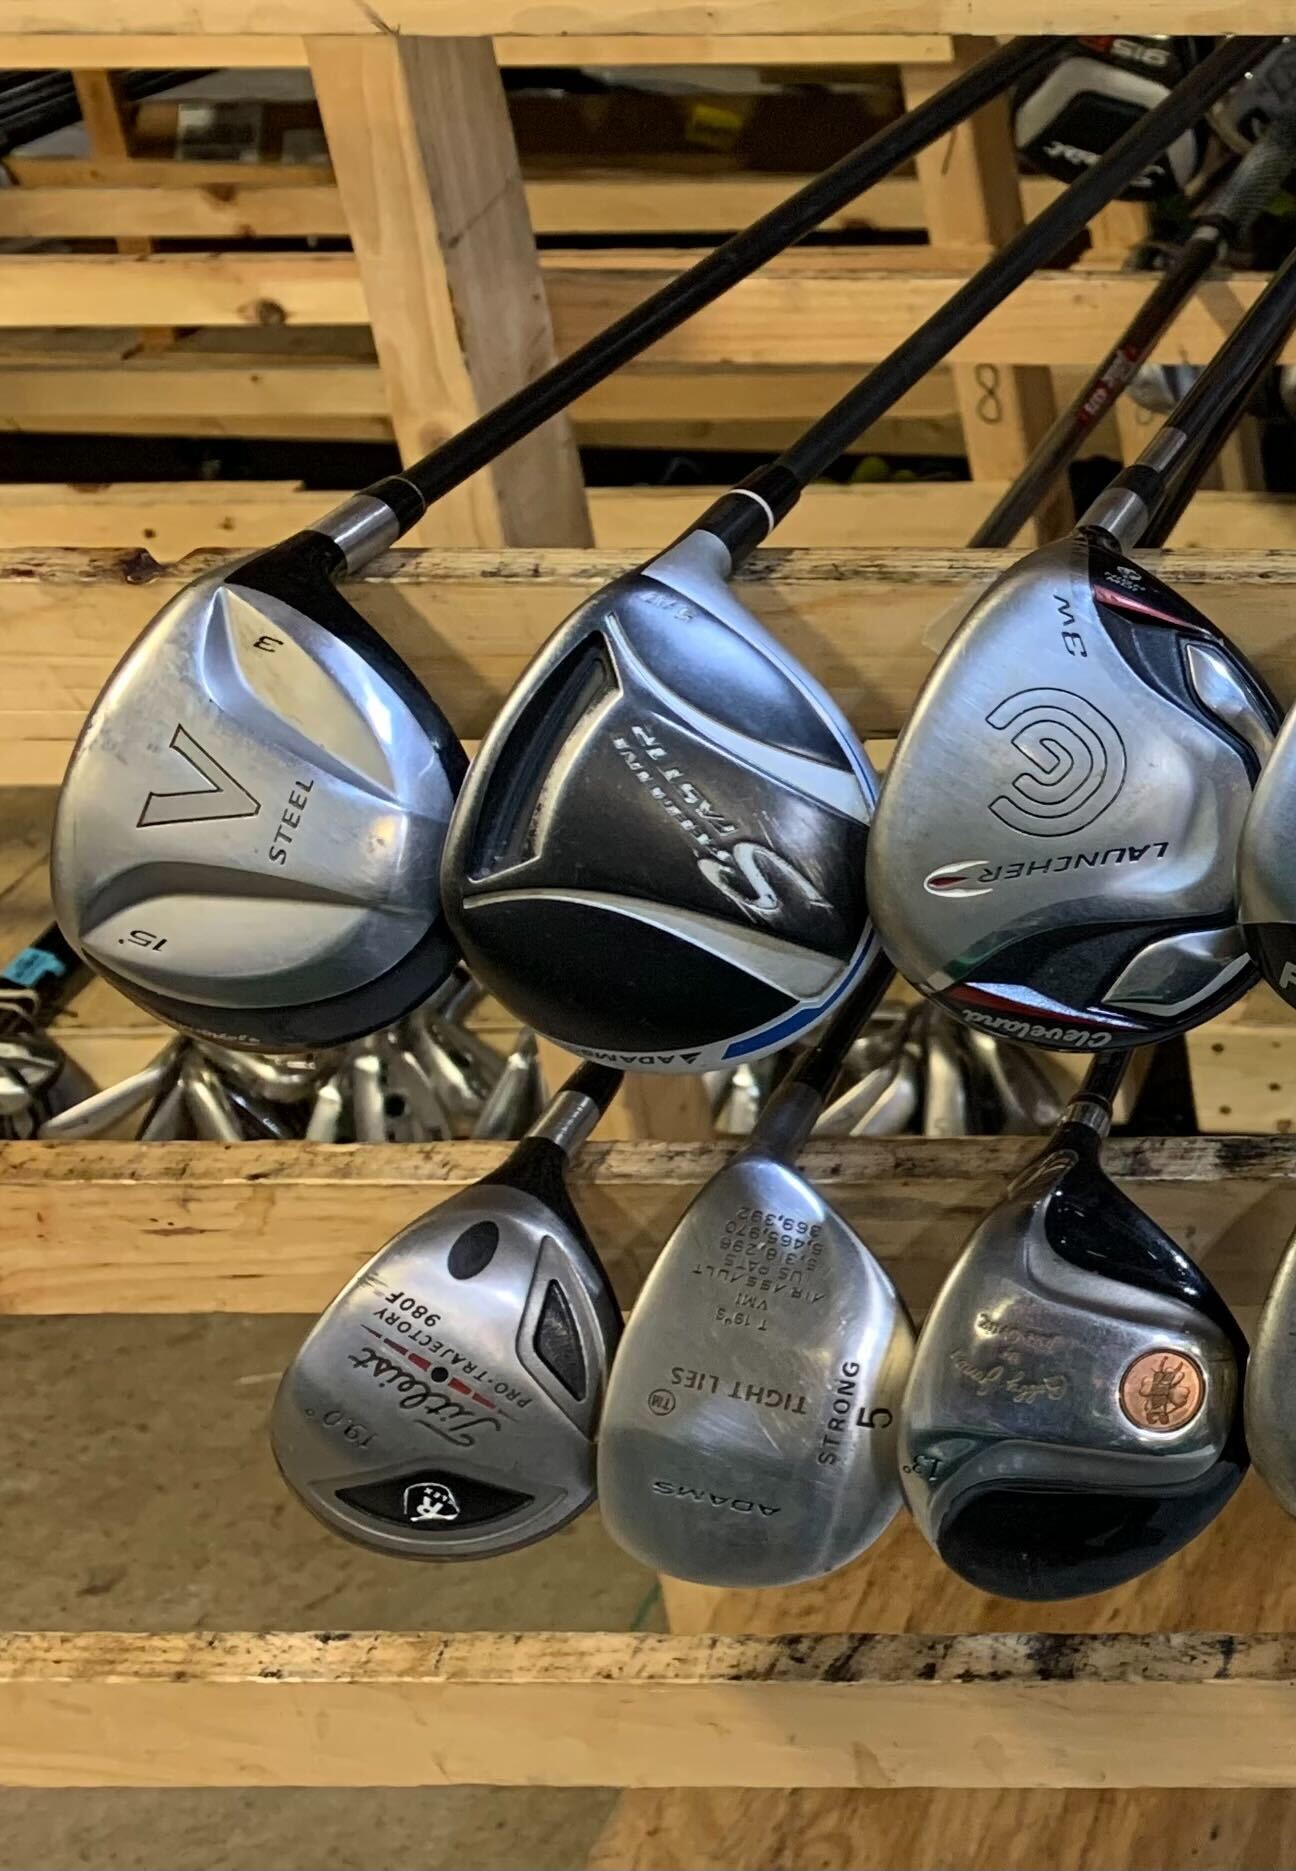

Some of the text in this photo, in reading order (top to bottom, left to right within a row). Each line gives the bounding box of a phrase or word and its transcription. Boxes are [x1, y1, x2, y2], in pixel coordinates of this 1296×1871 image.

[974, 362, 1003, 424] 8
[252, 634, 285, 654] 3
[1052, 594, 1088, 659] 3W
[136, 723, 261, 828] V
[269, 778, 315, 866] STEEL
[976, 840, 1172, 884] LAUNCHER
[962, 1008, 1113, 1050] Cleveland
[586, 1047, 672, 1065] ADAMS
[778, 1268, 803, 1283] US
[384, 1290, 442, 1329] 980F
[757, 1319, 769, 1332] T
[347, 1346, 502, 1448] Titleist
[671, 1365, 808, 1417] TIGHT LIES
[816, 1360, 861, 1466] STRONG
[856, 1406, 893, 1430] 5
[652, 1480, 782, 1517] ADAMS
